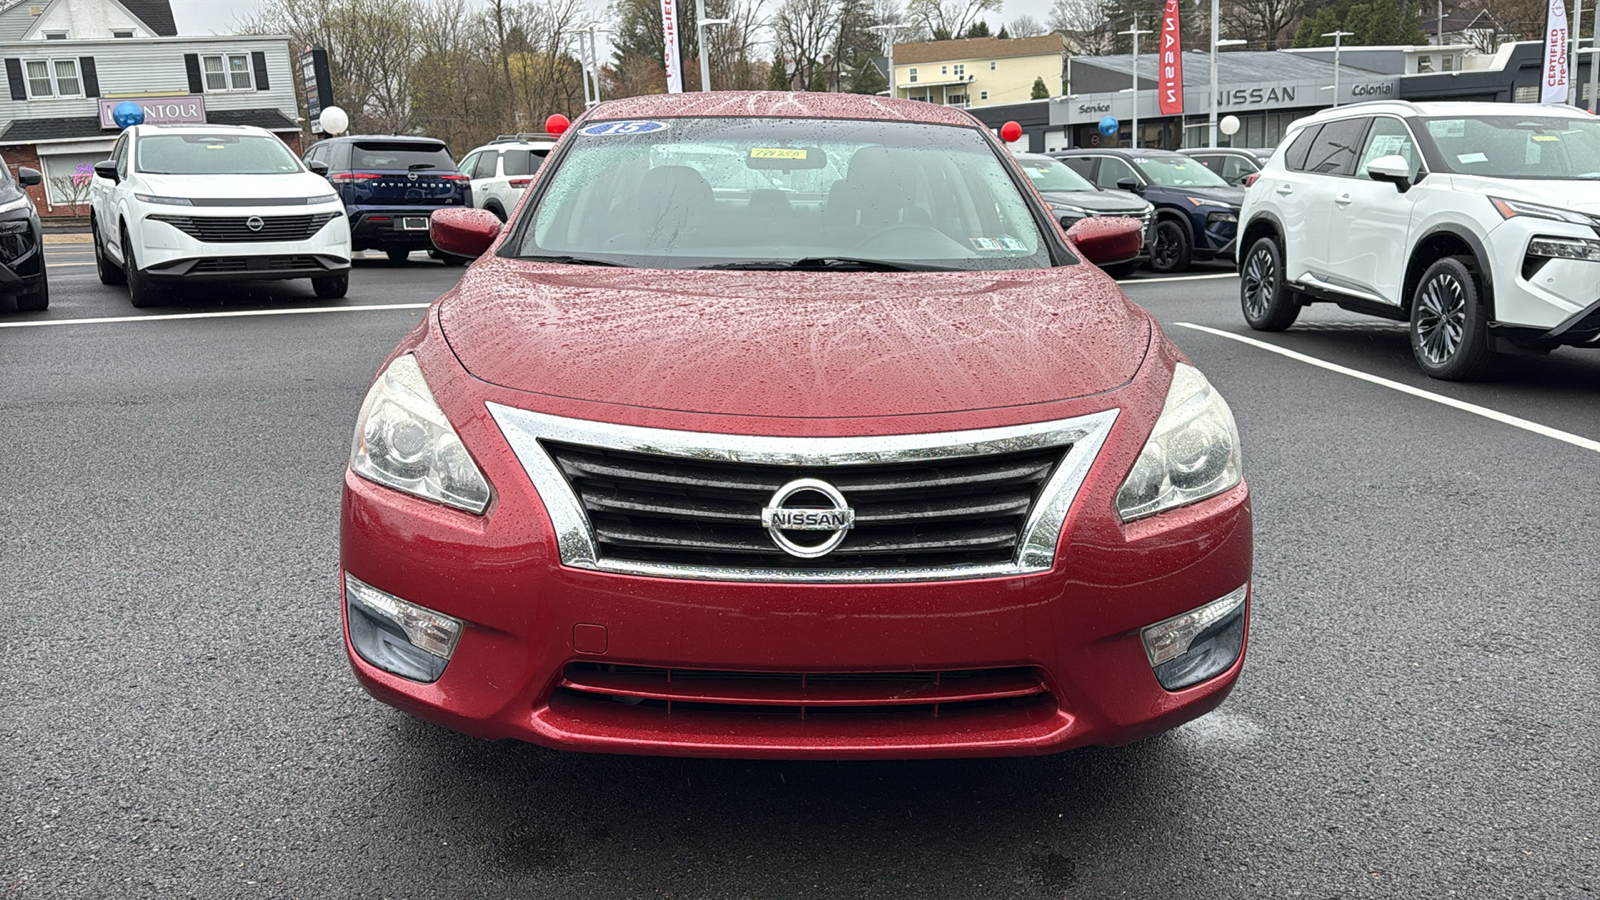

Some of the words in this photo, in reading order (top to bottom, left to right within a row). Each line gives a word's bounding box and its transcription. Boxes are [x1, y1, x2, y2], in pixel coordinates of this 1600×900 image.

[1548, 28, 1559, 87] CERTIFIED
[1557, 28, 1566, 86] Pre-Owned
[1208, 86, 1296, 108] NISSAN
[1352, 82, 1394, 97] Colonial
[1079, 103, 1111, 114] Service
[601, 121, 649, 134] 15
[772, 513, 845, 526] NISSAN
